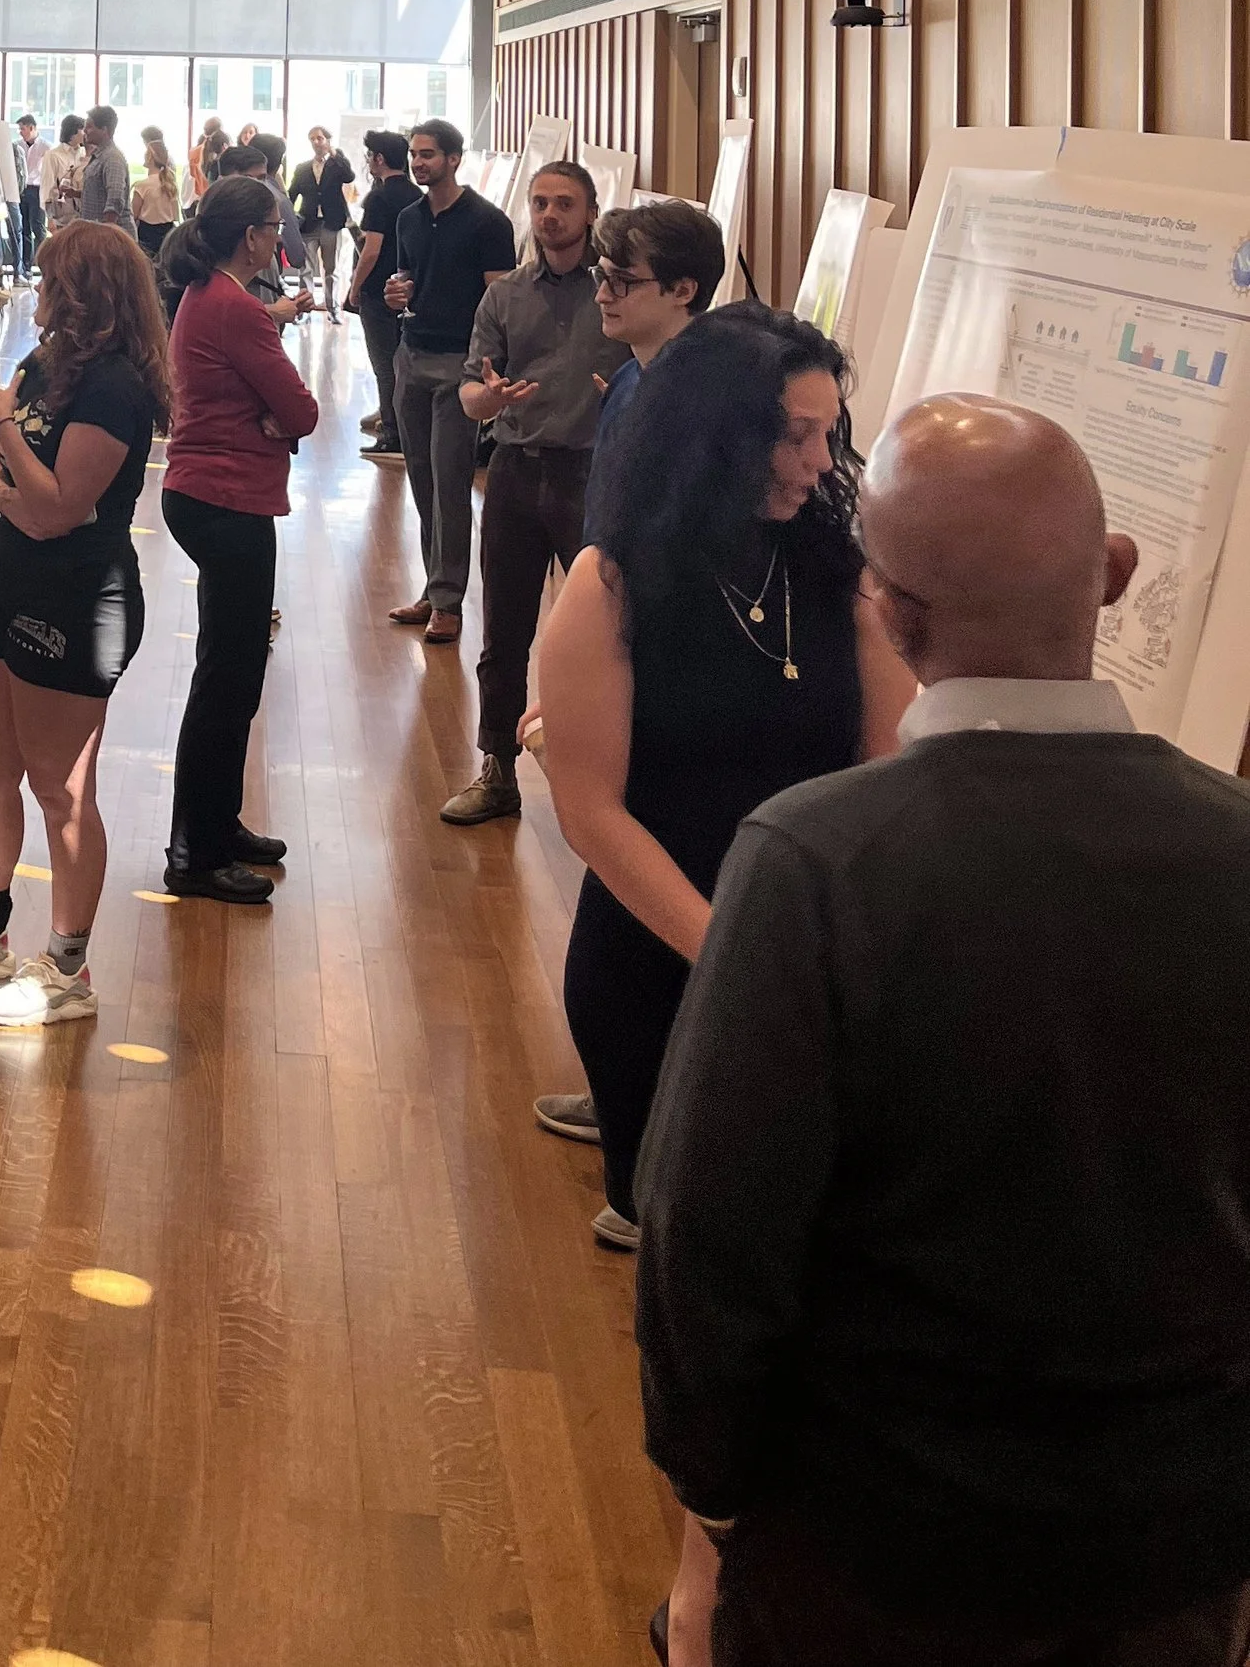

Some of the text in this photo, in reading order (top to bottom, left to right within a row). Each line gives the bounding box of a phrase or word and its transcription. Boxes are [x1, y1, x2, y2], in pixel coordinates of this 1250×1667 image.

[1123, 211, 1151, 228] Heating
[1151, 216, 1160, 227] at
[1160, 216, 1175, 231] City
[1175, 219, 1197, 233] Scale
